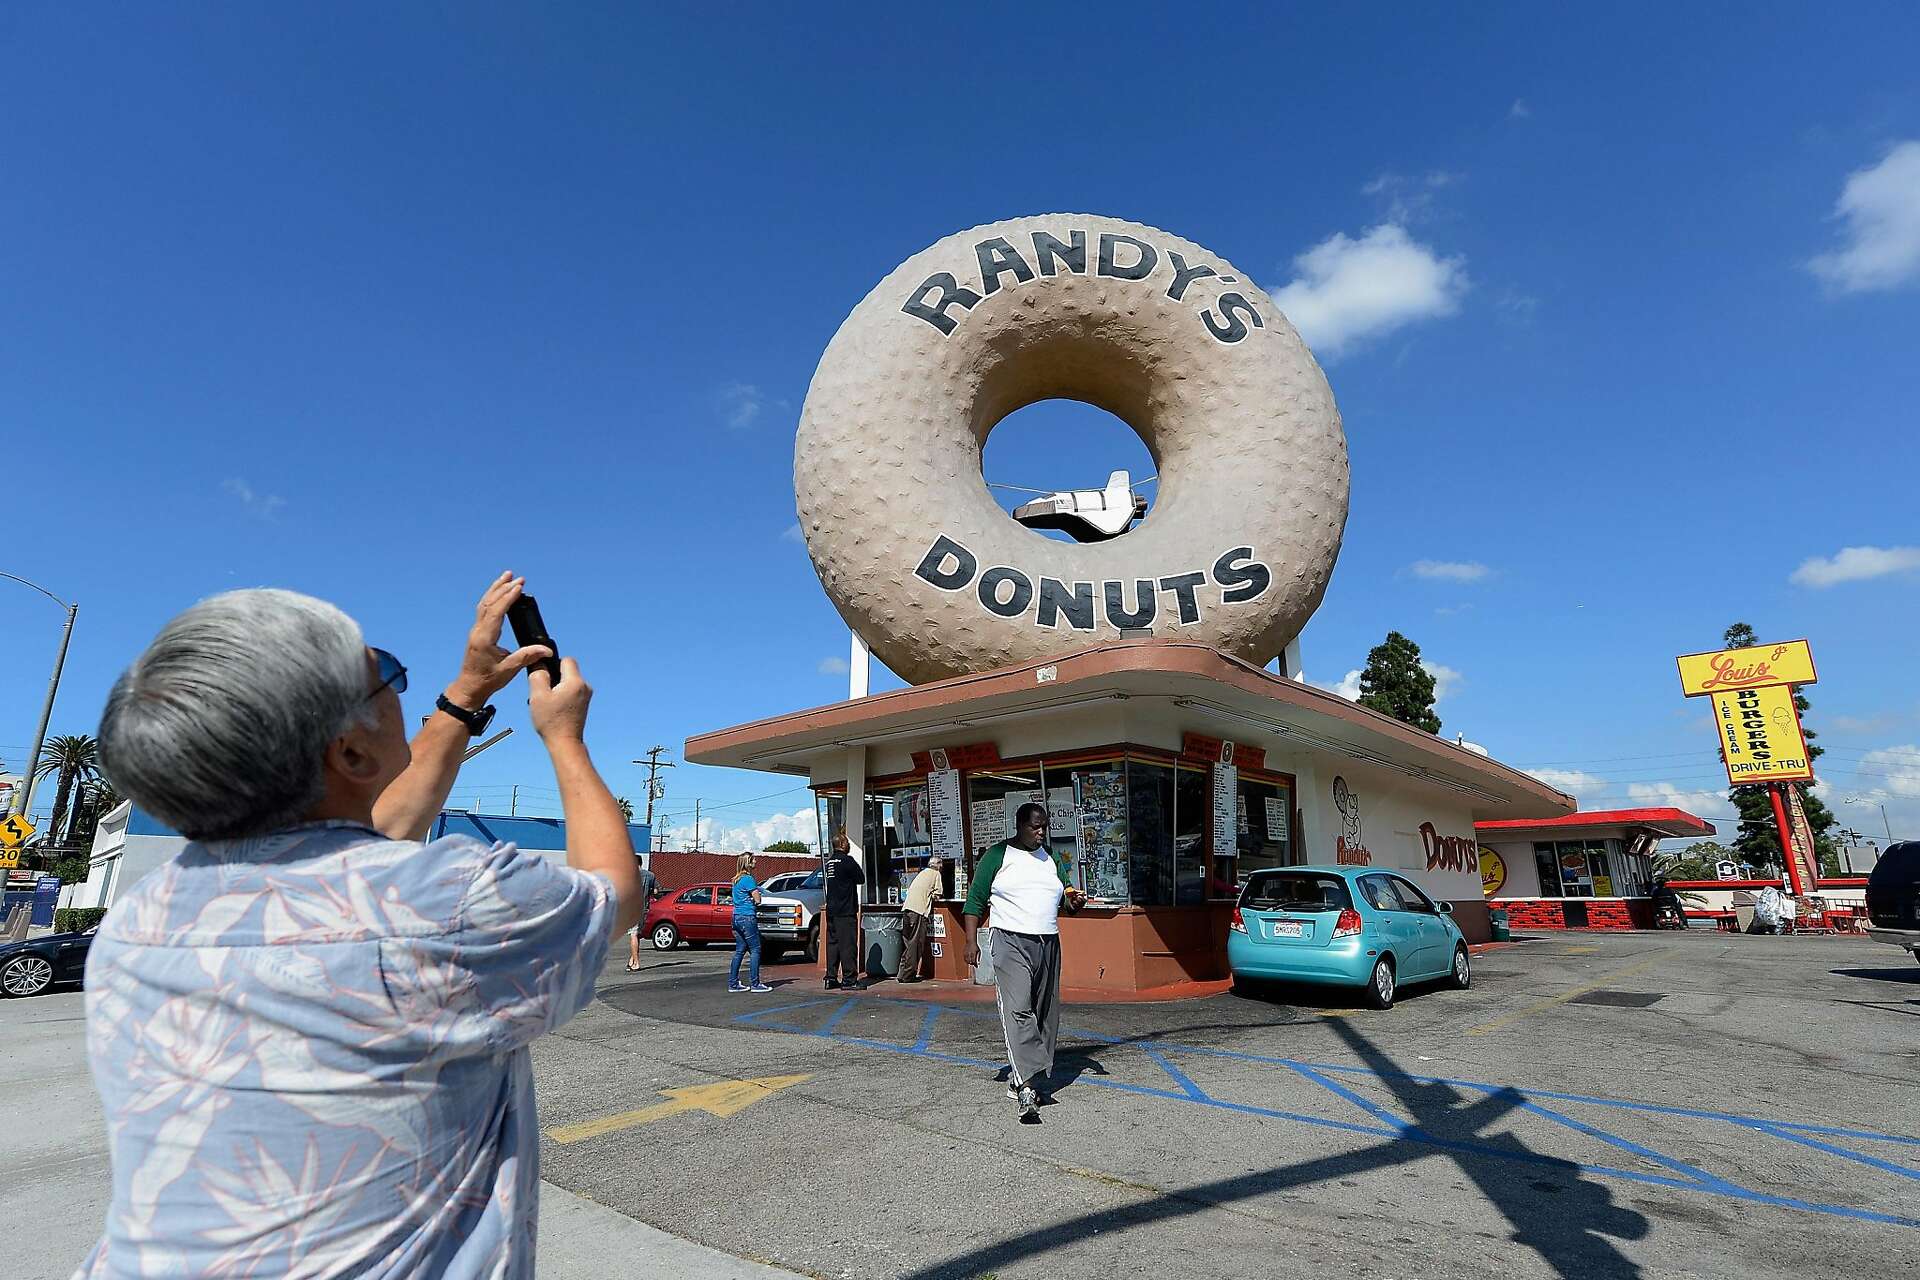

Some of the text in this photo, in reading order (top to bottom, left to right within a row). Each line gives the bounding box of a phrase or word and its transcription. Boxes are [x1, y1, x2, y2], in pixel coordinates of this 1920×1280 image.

[901, 230, 1264, 346] RANDY'S
[913, 533, 1272, 631] DONUTS
[1702, 653, 1776, 689] Louis
[1721, 700, 1741, 754] ICE CREAM
[1736, 690, 1772, 760] BURGERS
[1731, 759, 1806, 773] DRIVE-TRU
[1057, 809, 1074, 818] Chip
[1418, 821, 1478, 874] DONUTS
